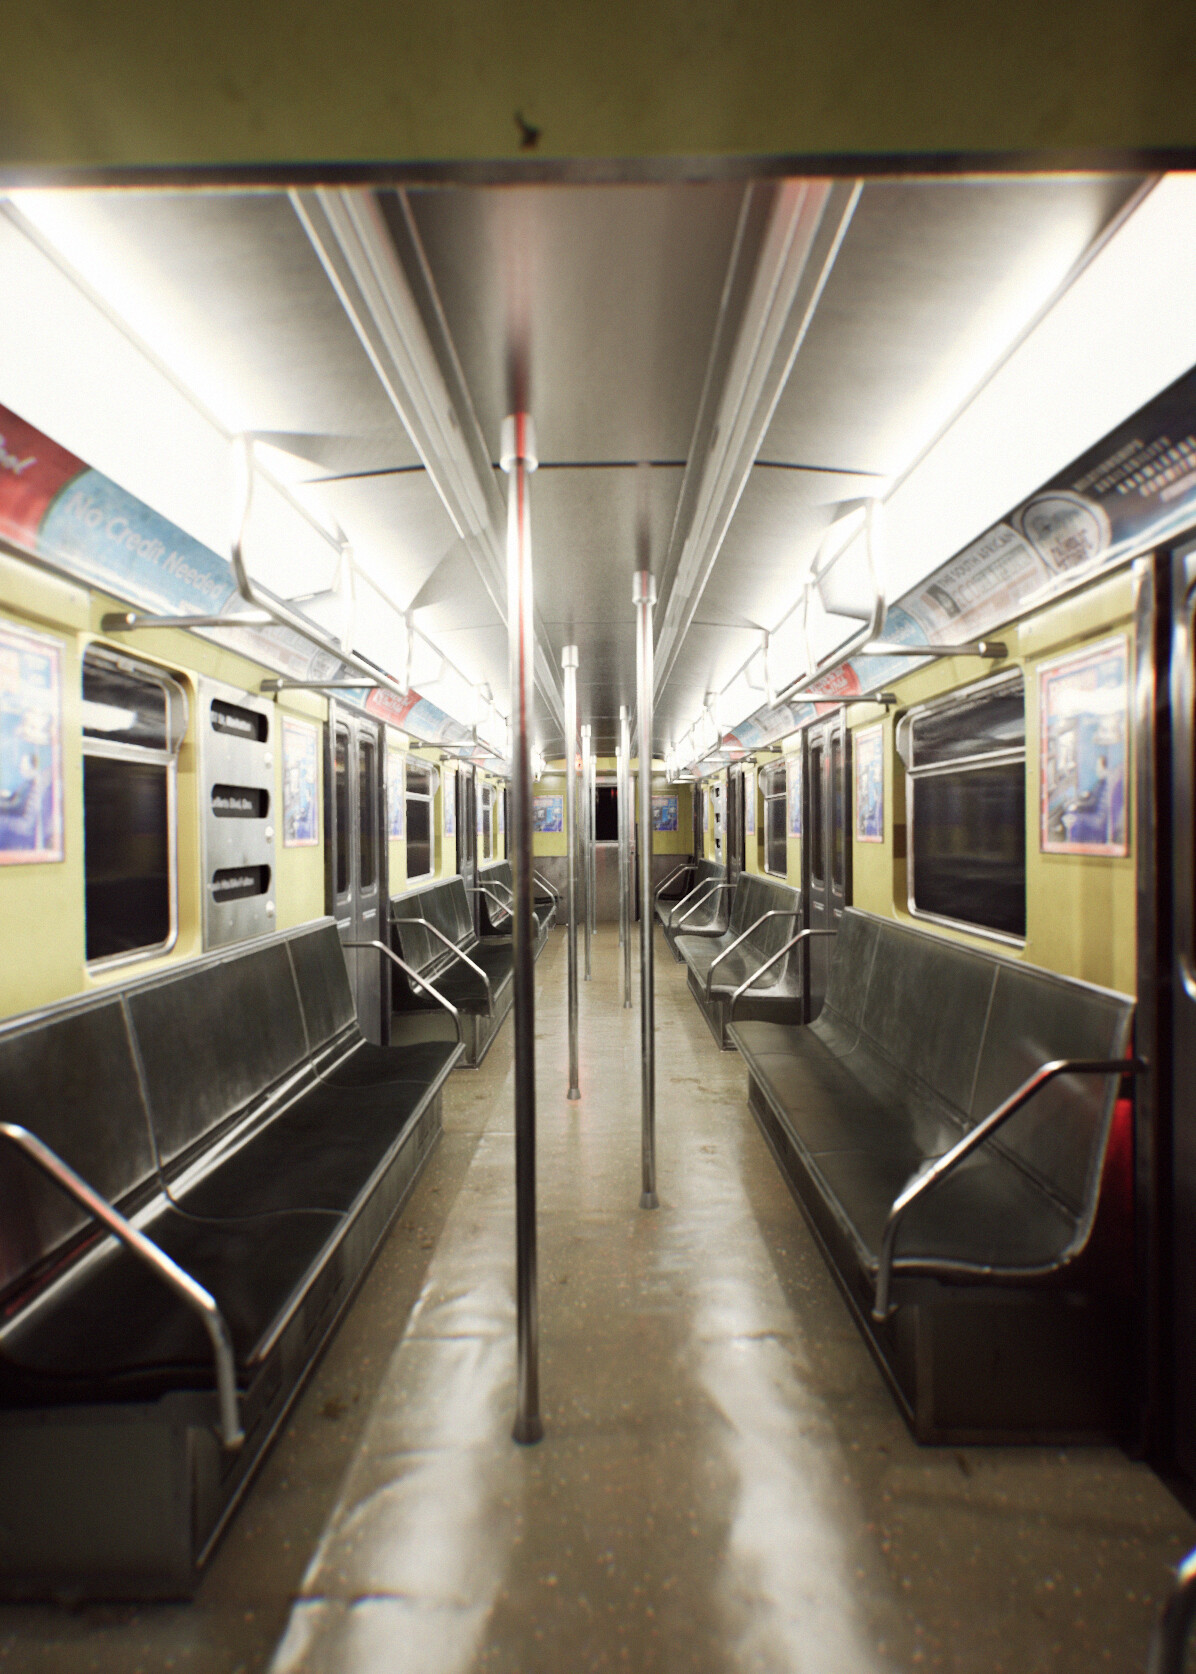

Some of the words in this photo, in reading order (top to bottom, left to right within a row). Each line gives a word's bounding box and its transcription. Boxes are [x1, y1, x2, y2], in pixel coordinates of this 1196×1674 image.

[64, 491, 103, 527] No
[105, 516, 166, 565] Credit
[161, 550, 228, 599] Needed
